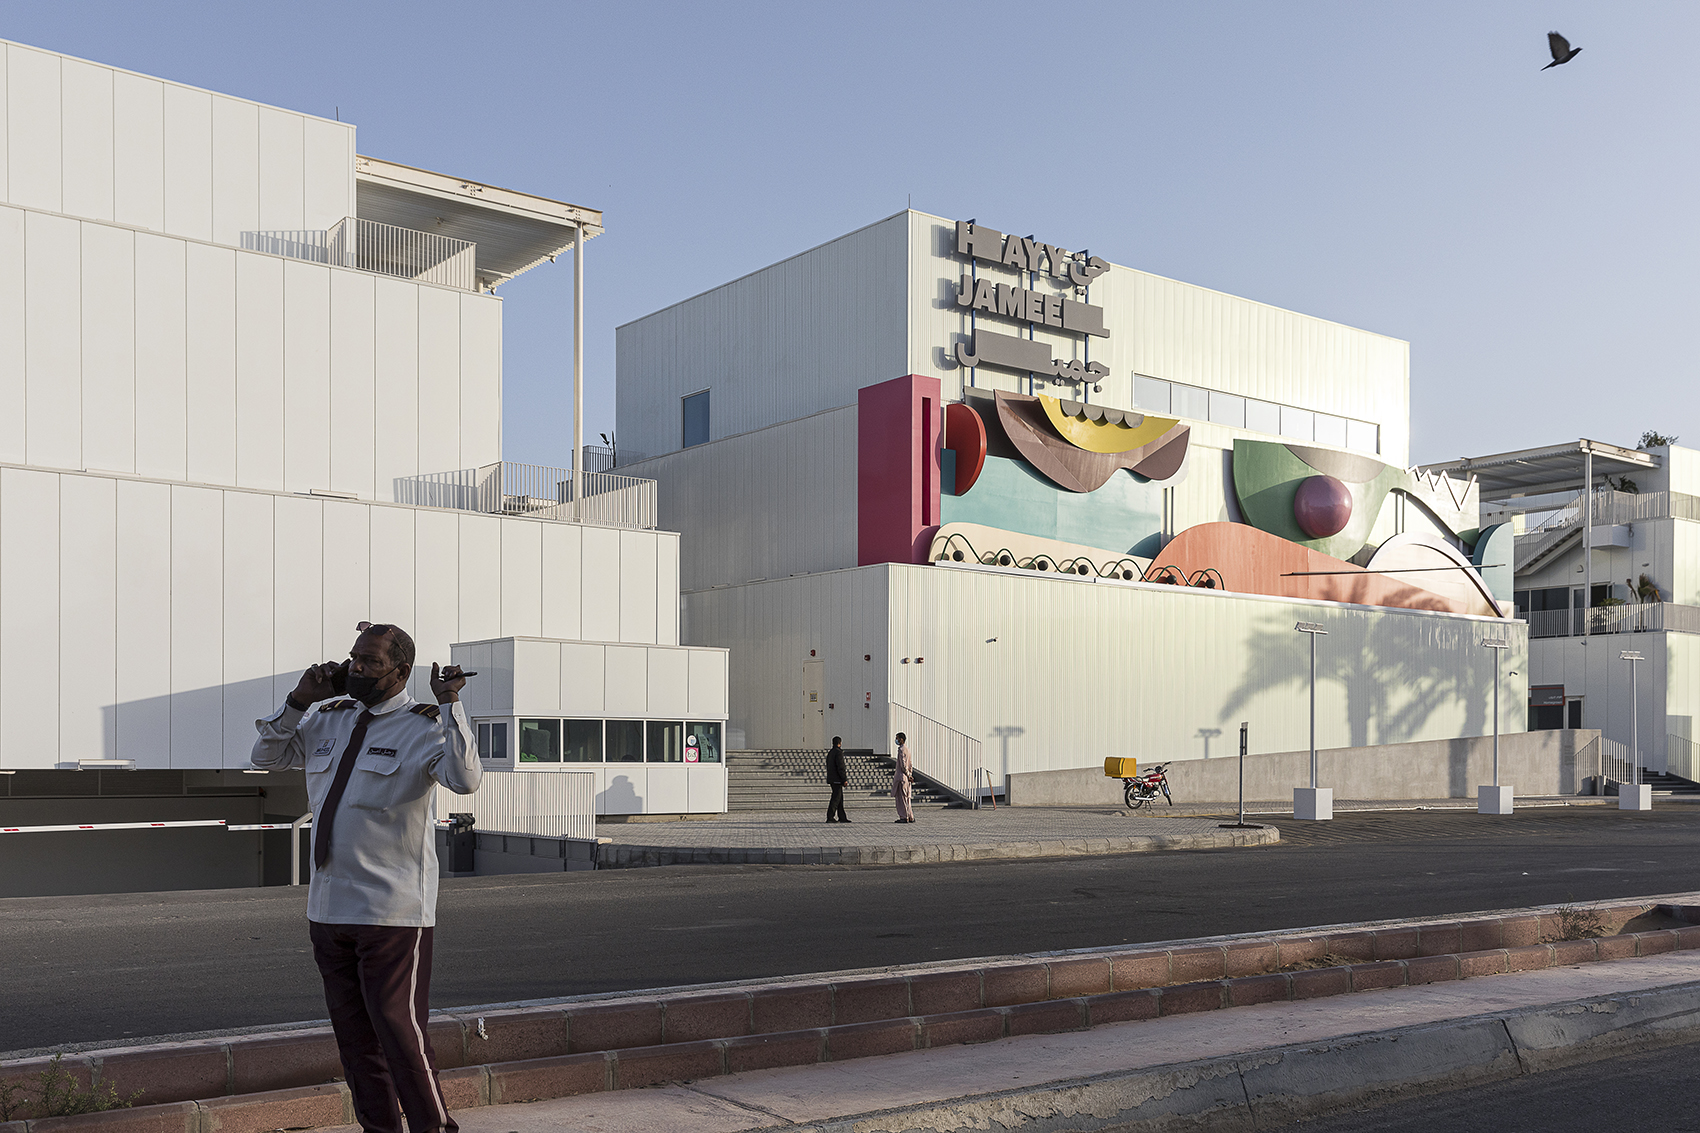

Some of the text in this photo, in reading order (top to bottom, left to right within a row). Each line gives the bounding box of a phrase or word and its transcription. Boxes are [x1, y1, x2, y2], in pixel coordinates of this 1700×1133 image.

[956, 220, 1067, 277] HAYY
[957, 274, 1110, 338] JAMEEL
[955, 328, 1110, 393] جميل
